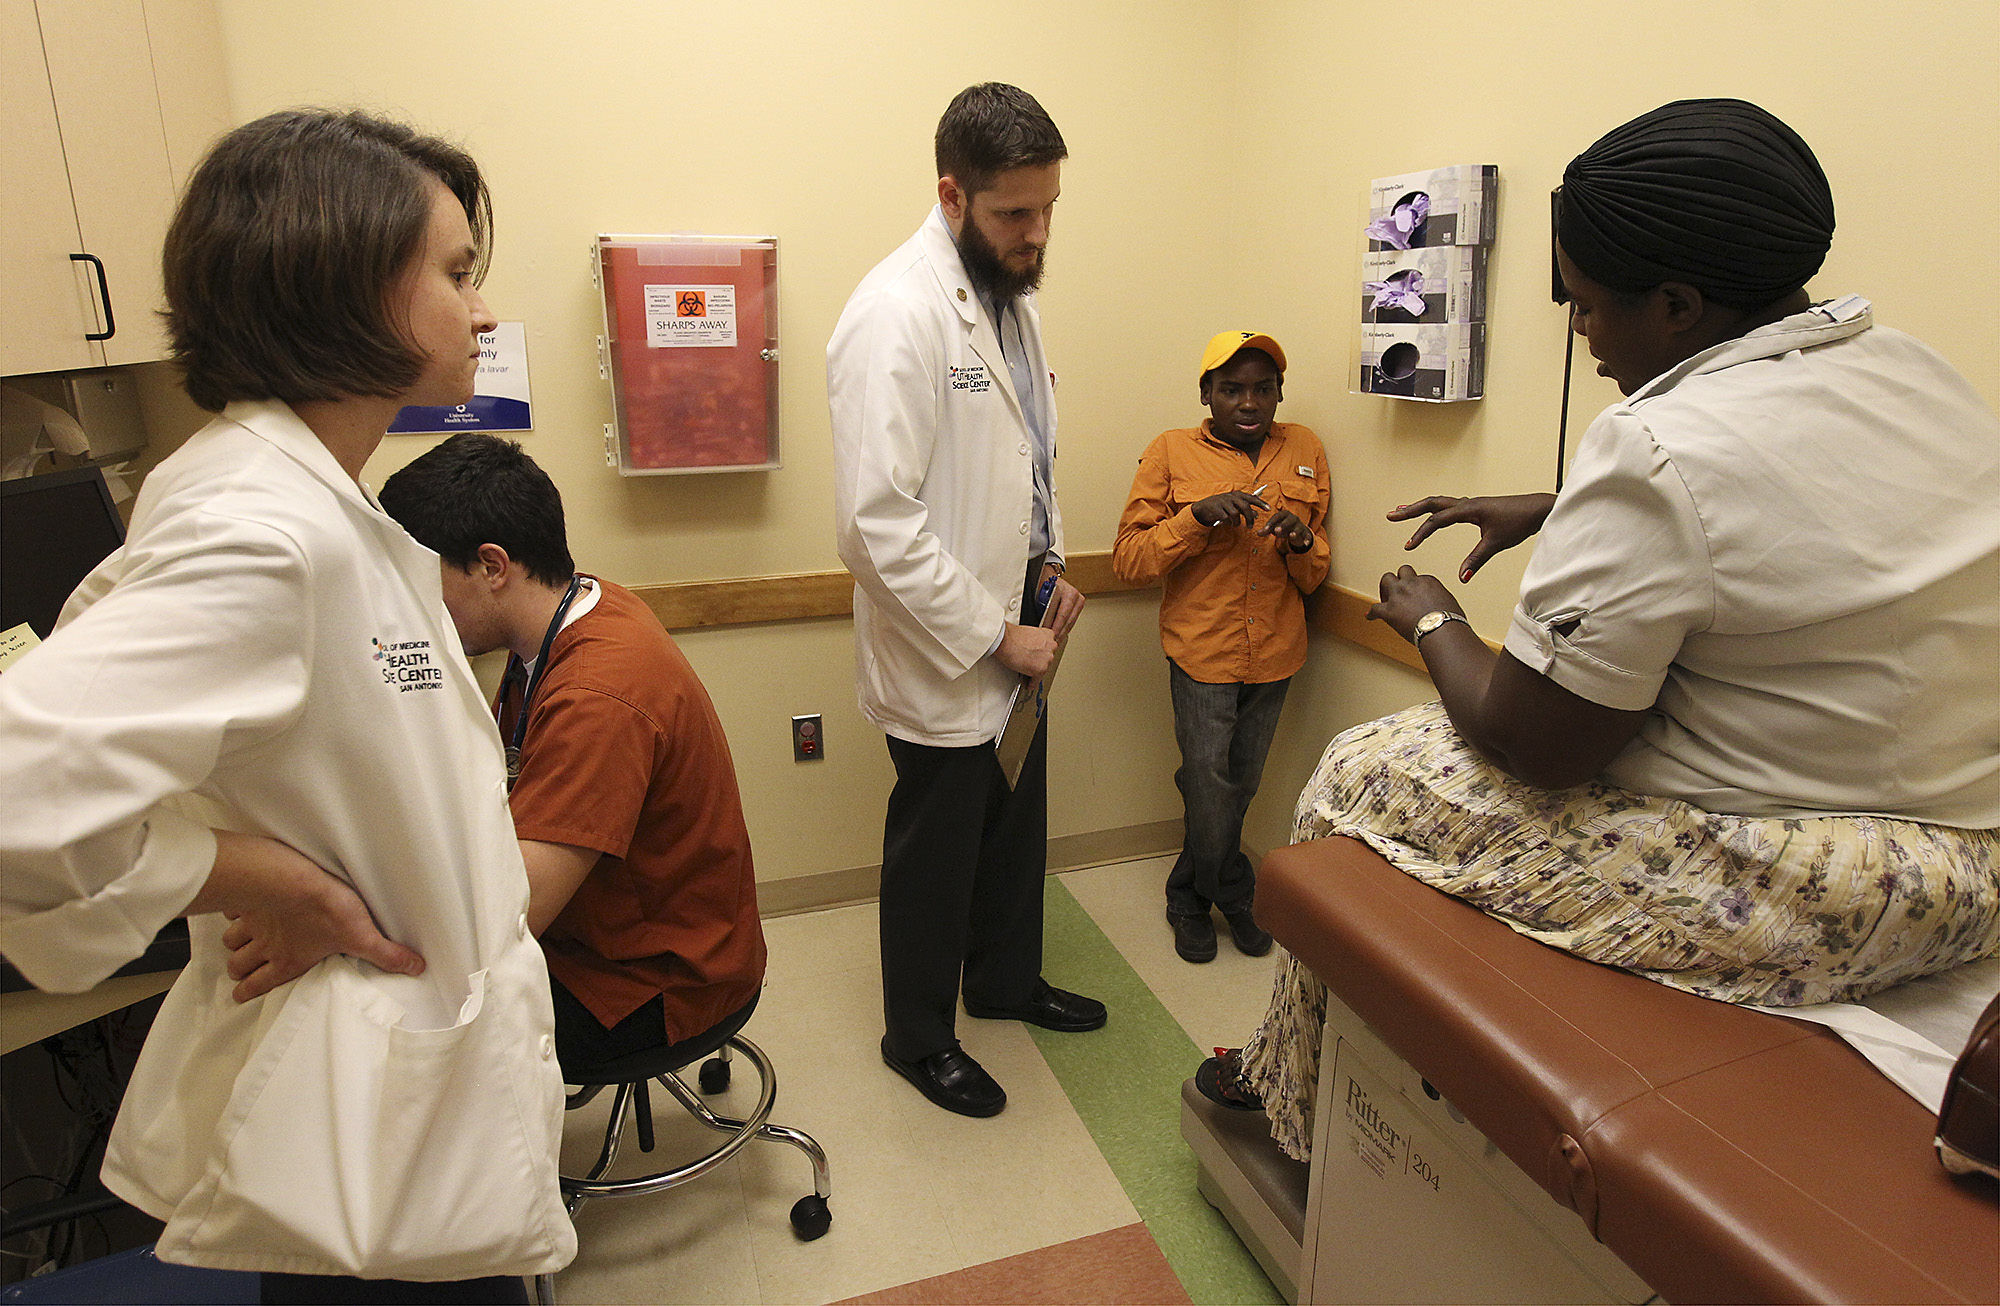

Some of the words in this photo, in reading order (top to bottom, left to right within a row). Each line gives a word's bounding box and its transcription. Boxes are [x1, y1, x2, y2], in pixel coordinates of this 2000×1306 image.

[656, 320, 696, 330] SHARPS
[699, 320, 728, 330] AWAY
[480, 335, 496, 344] for
[481, 349, 497, 360] nly
[487, 364, 509, 373] lavar
[969, 380, 991, 388] CENTER
[390, 643, 398, 651] OF
[399, 641, 431, 650] MEDICINE
[400, 684, 413, 693] SAN
[414, 682, 443, 690] ANTONIO
[1345, 1075, 1400, 1150] Ritter
[1412, 1153, 1441, 1193] 204
